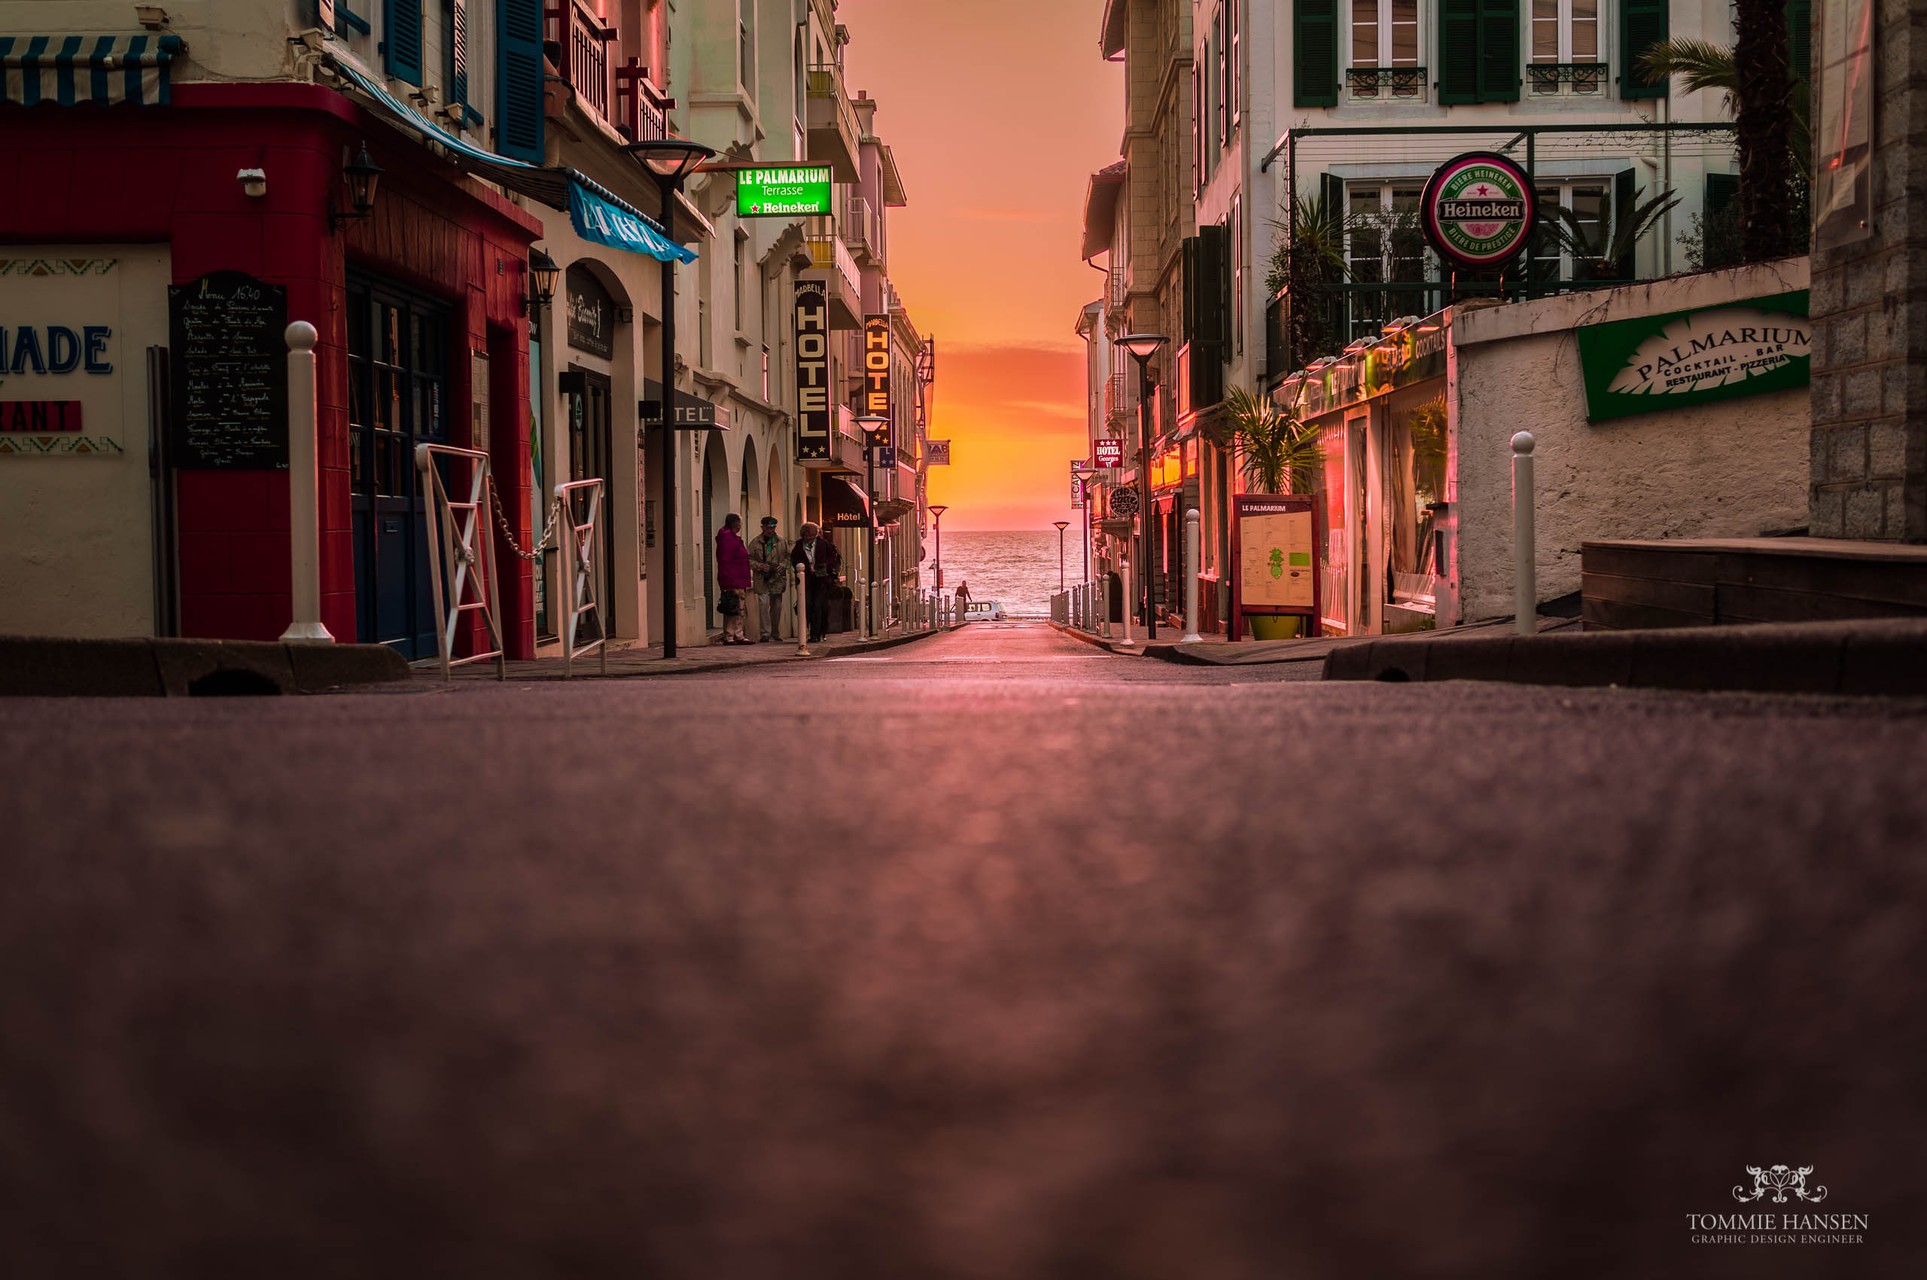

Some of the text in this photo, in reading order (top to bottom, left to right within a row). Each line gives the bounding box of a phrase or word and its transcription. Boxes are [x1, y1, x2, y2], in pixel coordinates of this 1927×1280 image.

[739, 168, 829, 185] LE PALMARIUM
[1474, 169, 1513, 191] HEINEKEN
[762, 185, 804, 196] Terrasse
[762, 201, 819, 214] Heineken
[1443, 202, 1520, 217] Heineken
[1469, 241, 1481, 251] DE
[1482, 226, 1515, 251] PRESTIGE
[795, 283, 826, 303] MARBELLA
[1664, 344, 1784, 377] COCKTAIL BAR
[797, 306, 827, 438] HOTEL
[1666, 354, 1786, 388] RESTAURANT PIZZERIA
[0, 401, 70, 431] ANT
[1096, 446, 1121, 455] HOTEL
[837, 512, 861, 521] Hôtel
